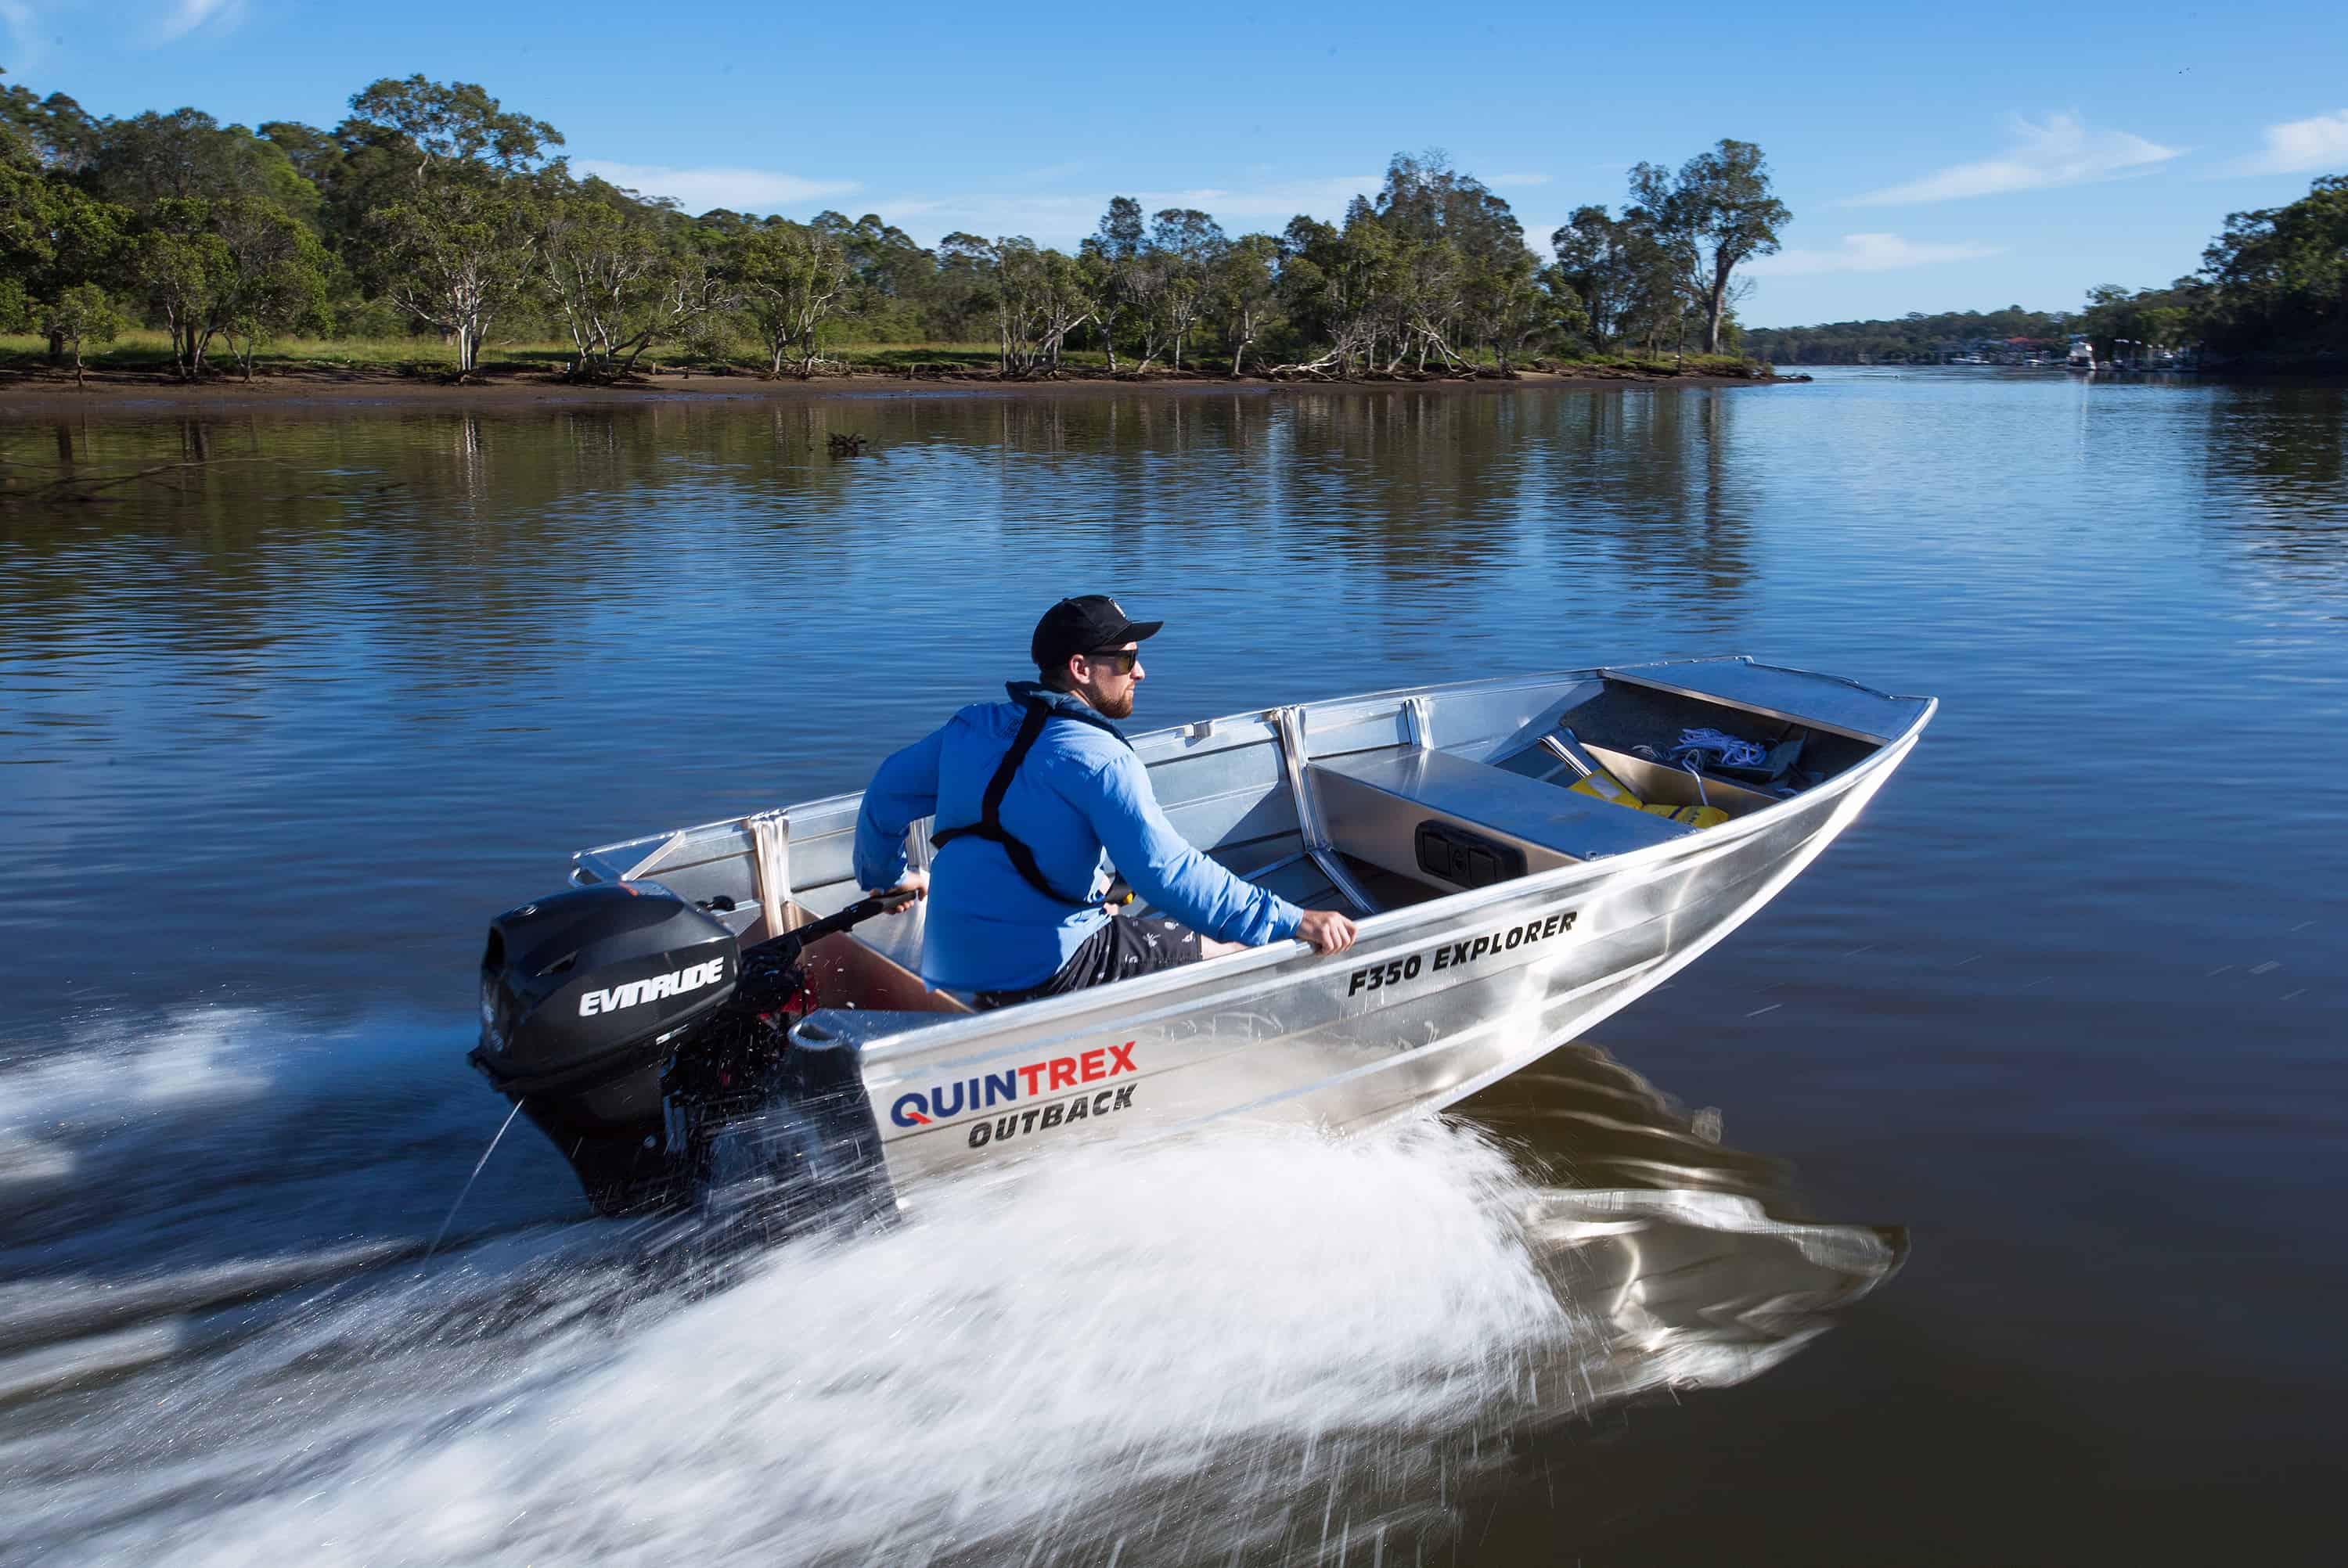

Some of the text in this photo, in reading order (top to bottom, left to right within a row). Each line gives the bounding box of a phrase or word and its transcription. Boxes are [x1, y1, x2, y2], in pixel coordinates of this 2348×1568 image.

[578, 956, 724, 1017] EVINRUDE
[1348, 912, 1578, 997] F350 EXPLORER
[891, 1041, 1138, 1127] QUINTREX
[968, 1083, 1138, 1149] OUTBACK
